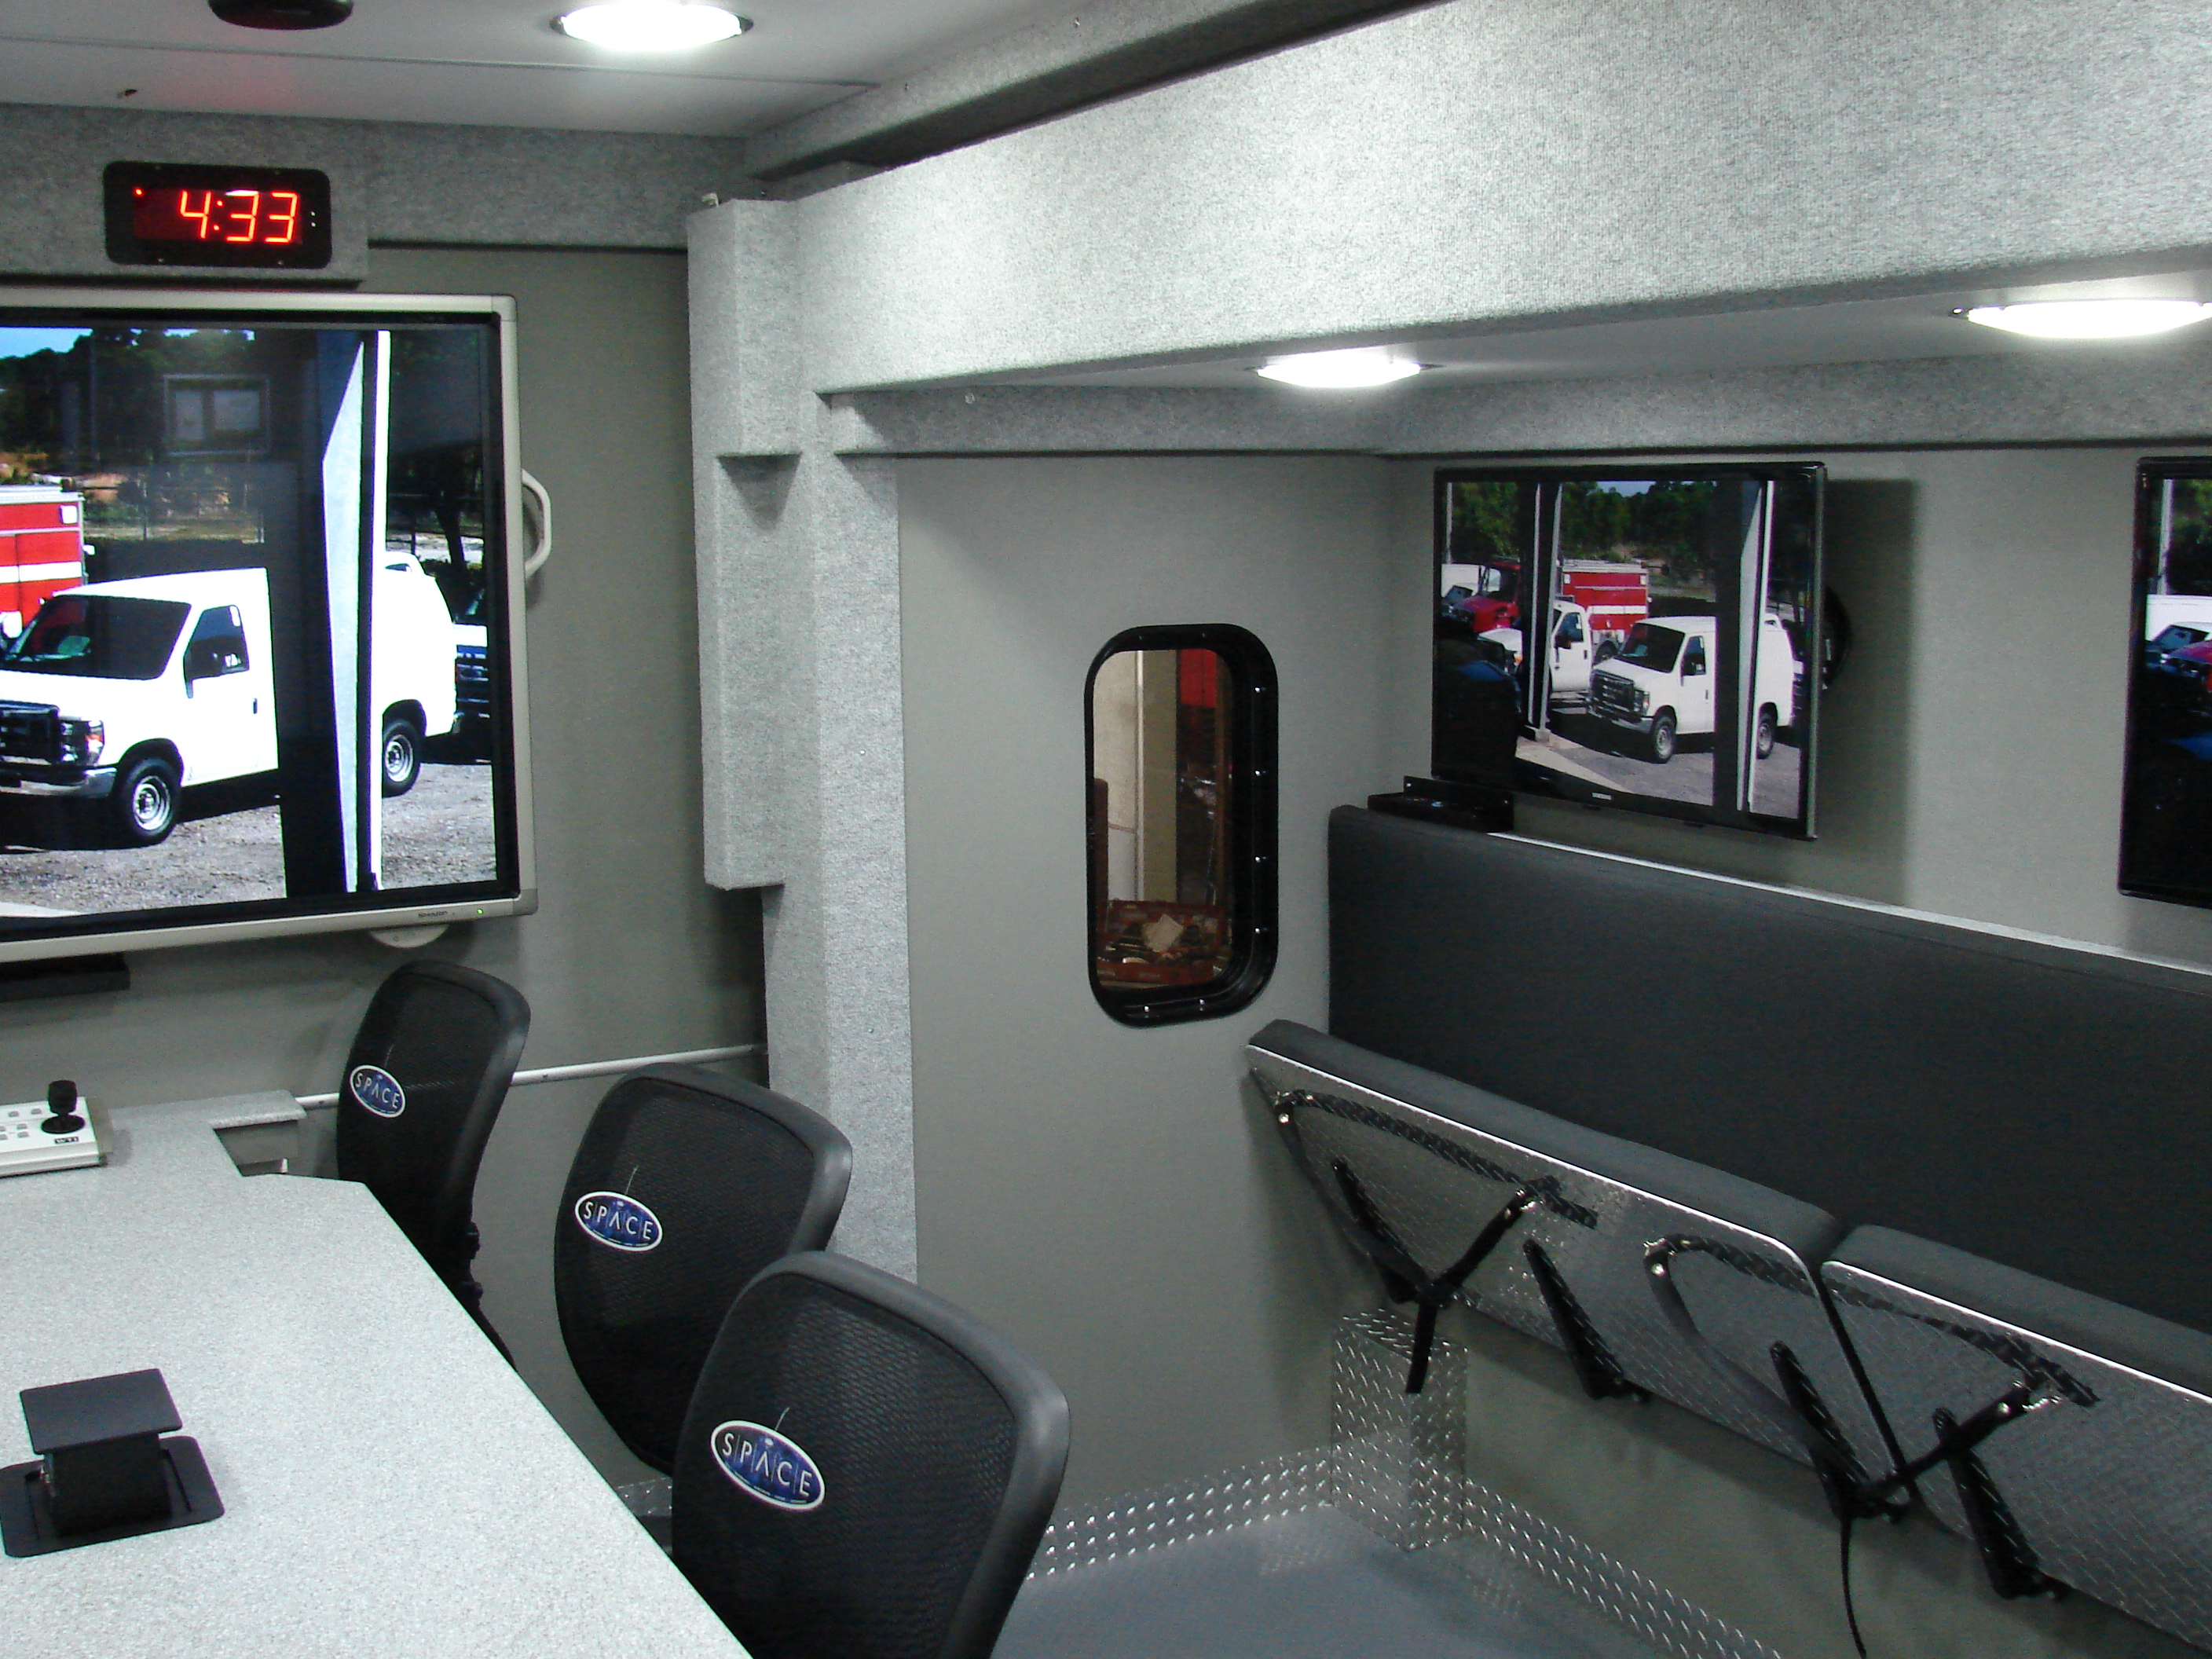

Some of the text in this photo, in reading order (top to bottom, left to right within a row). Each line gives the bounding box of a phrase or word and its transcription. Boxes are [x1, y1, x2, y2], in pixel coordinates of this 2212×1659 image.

[178, 189, 298, 244] 4:33
[355, 1072, 401, 1109] SPACE
[583, 1201, 654, 1240] SPACE
[722, 1432, 812, 1497] SPACE
